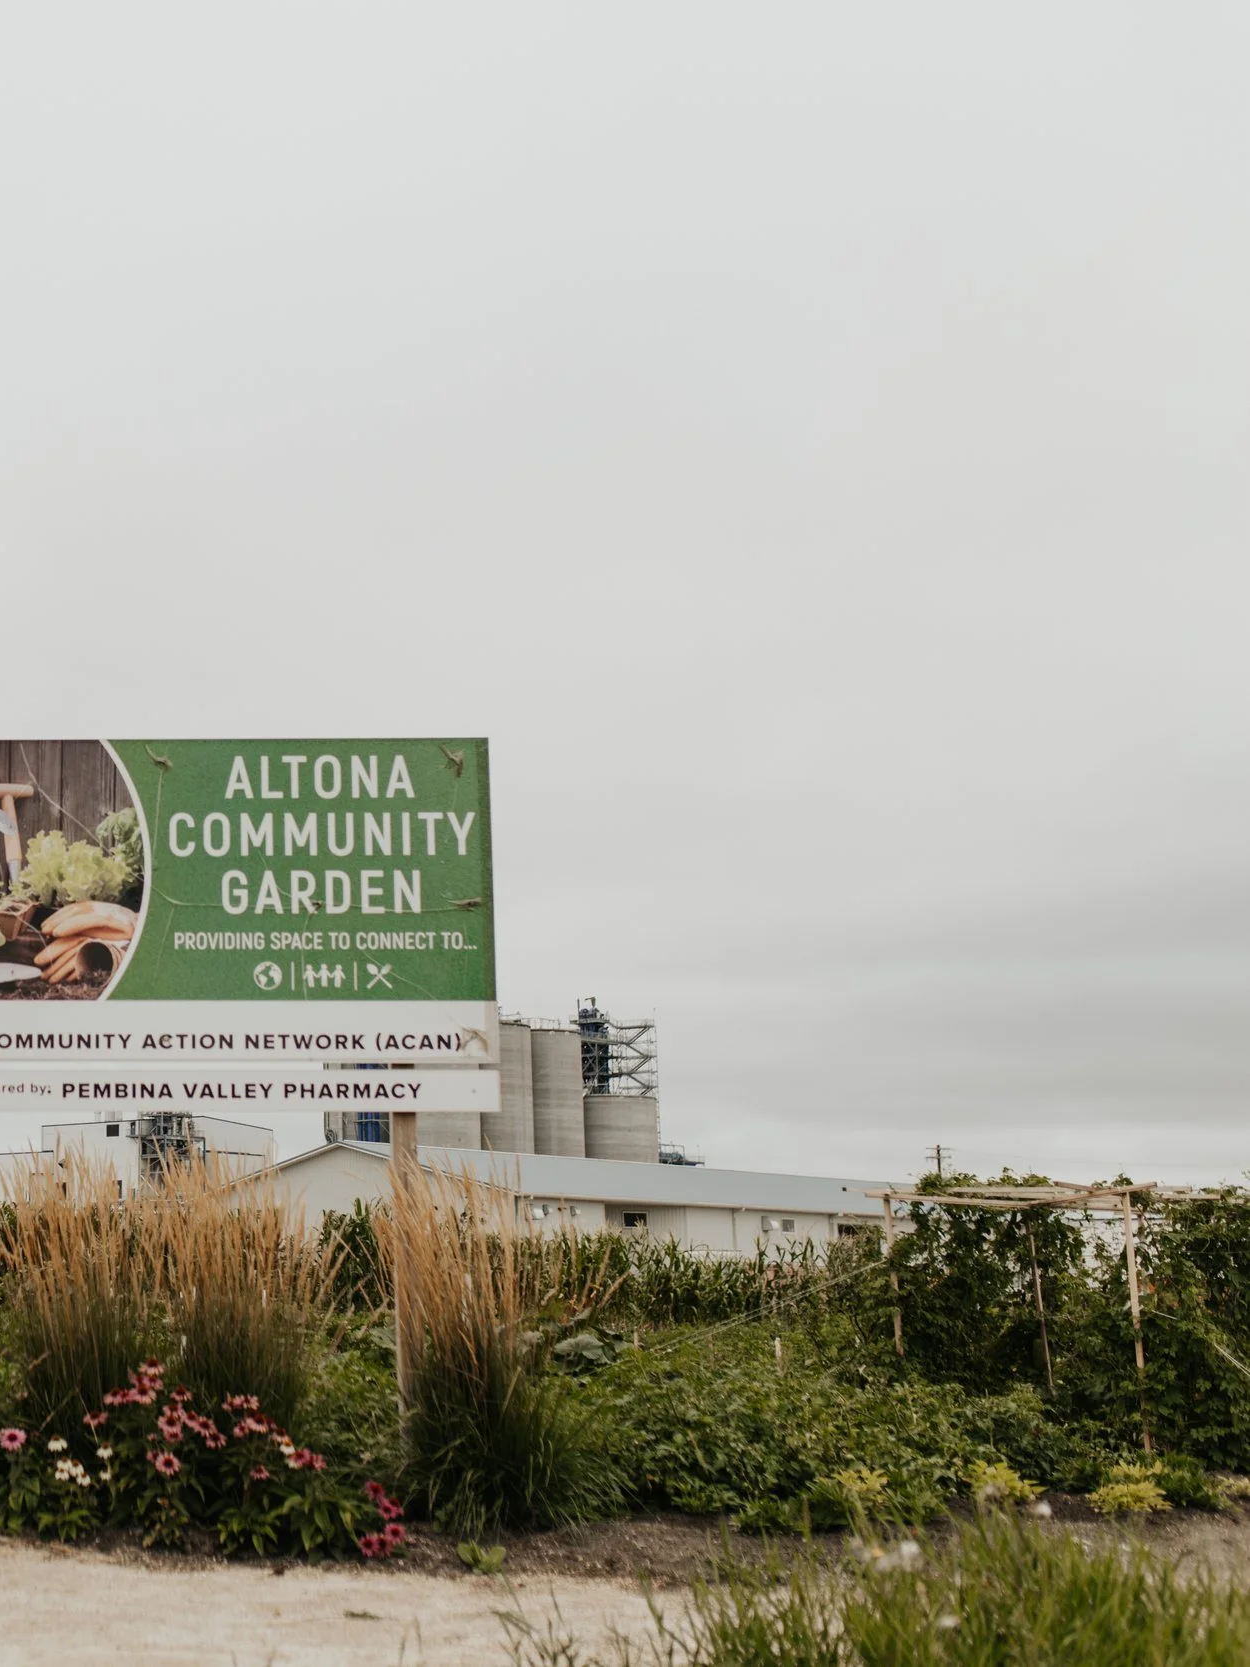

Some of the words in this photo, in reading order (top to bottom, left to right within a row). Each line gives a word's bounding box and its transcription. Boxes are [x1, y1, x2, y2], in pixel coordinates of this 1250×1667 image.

[224, 754, 416, 800] ALTONA
[168, 811, 476, 858] COMMUNITY
[220, 869, 423, 915] GARDEN
[173, 931, 265, 950] PROVIDING
[269, 931, 323, 950] SPACE
[328, 931, 351, 950] TO
[355, 931, 437, 950] CONNECT
[440, 931, 478, 950] TO...
[141, 1033, 235, 1050] ACTION
[244, 1033, 366, 1050] NETWORK
[375, 1032, 462, 1052] (ACAN)
[29, 1082, 52, 1095] by:
[61, 1082, 173, 1099] PEMBINA
[182, 1082, 274, 1099] VALLEY
[283, 1082, 423, 1099] PHARMACY
